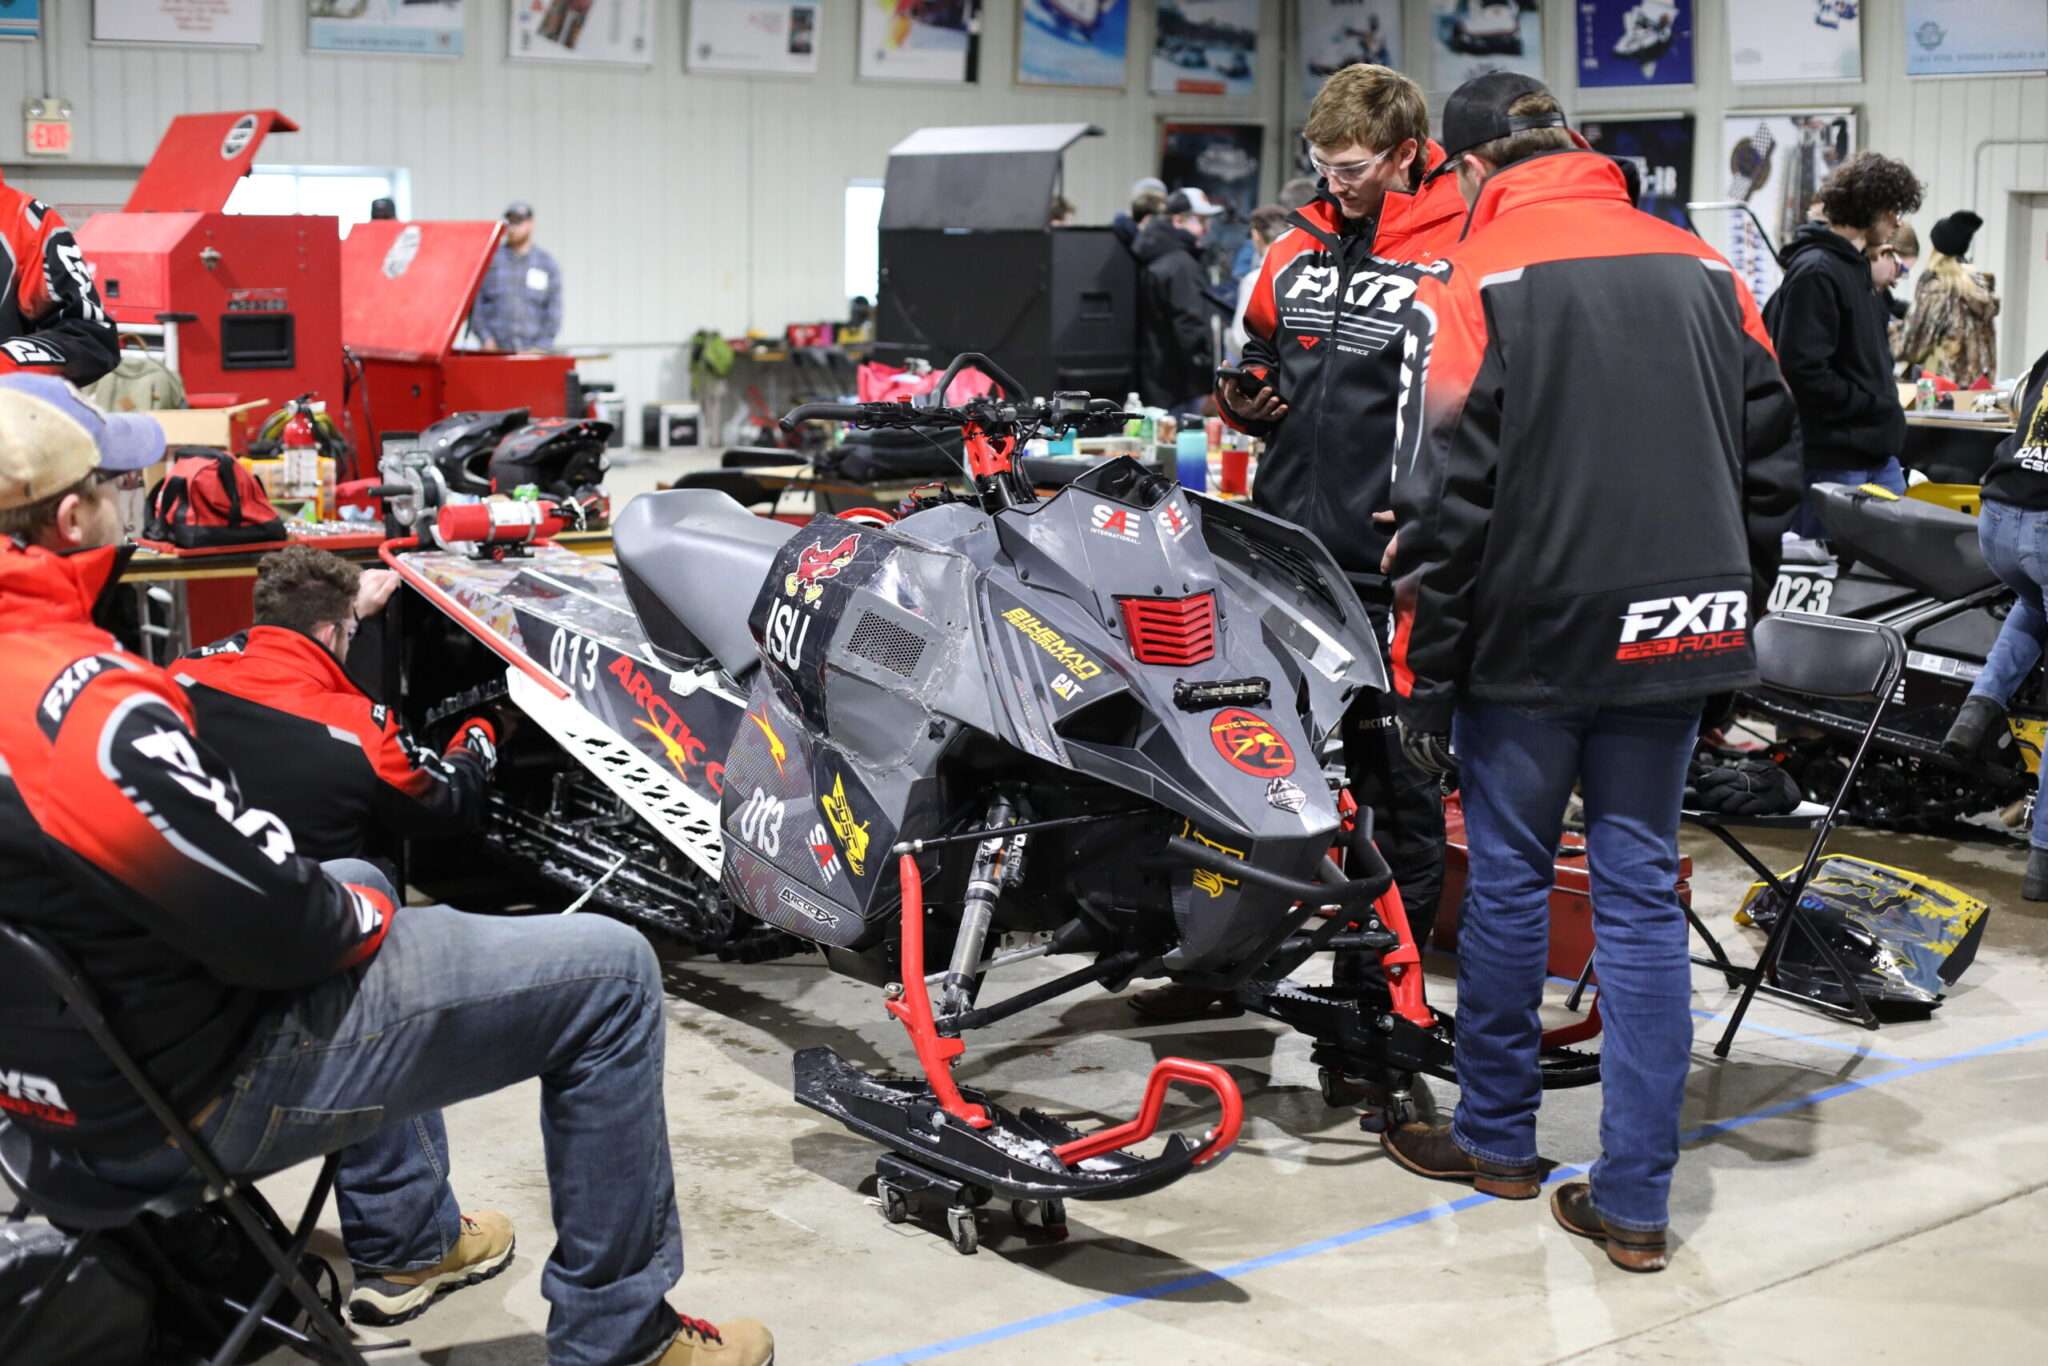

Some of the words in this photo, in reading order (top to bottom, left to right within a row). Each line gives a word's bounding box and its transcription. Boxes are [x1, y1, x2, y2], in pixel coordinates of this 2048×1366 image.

[1284, 264, 1418, 314] FXR
[1090, 504, 1141, 538] SAE
[1618, 590, 1749, 643] FXR
[1766, 574, 1833, 615] 023
[550, 628, 600, 691] 013
[765, 597, 811, 670] ISU
[607, 655, 707, 766] ARCTIC
[1050, 673, 1085, 701] CAT
[740, 786, 785, 858] 013
[809, 823, 842, 882] SAE
